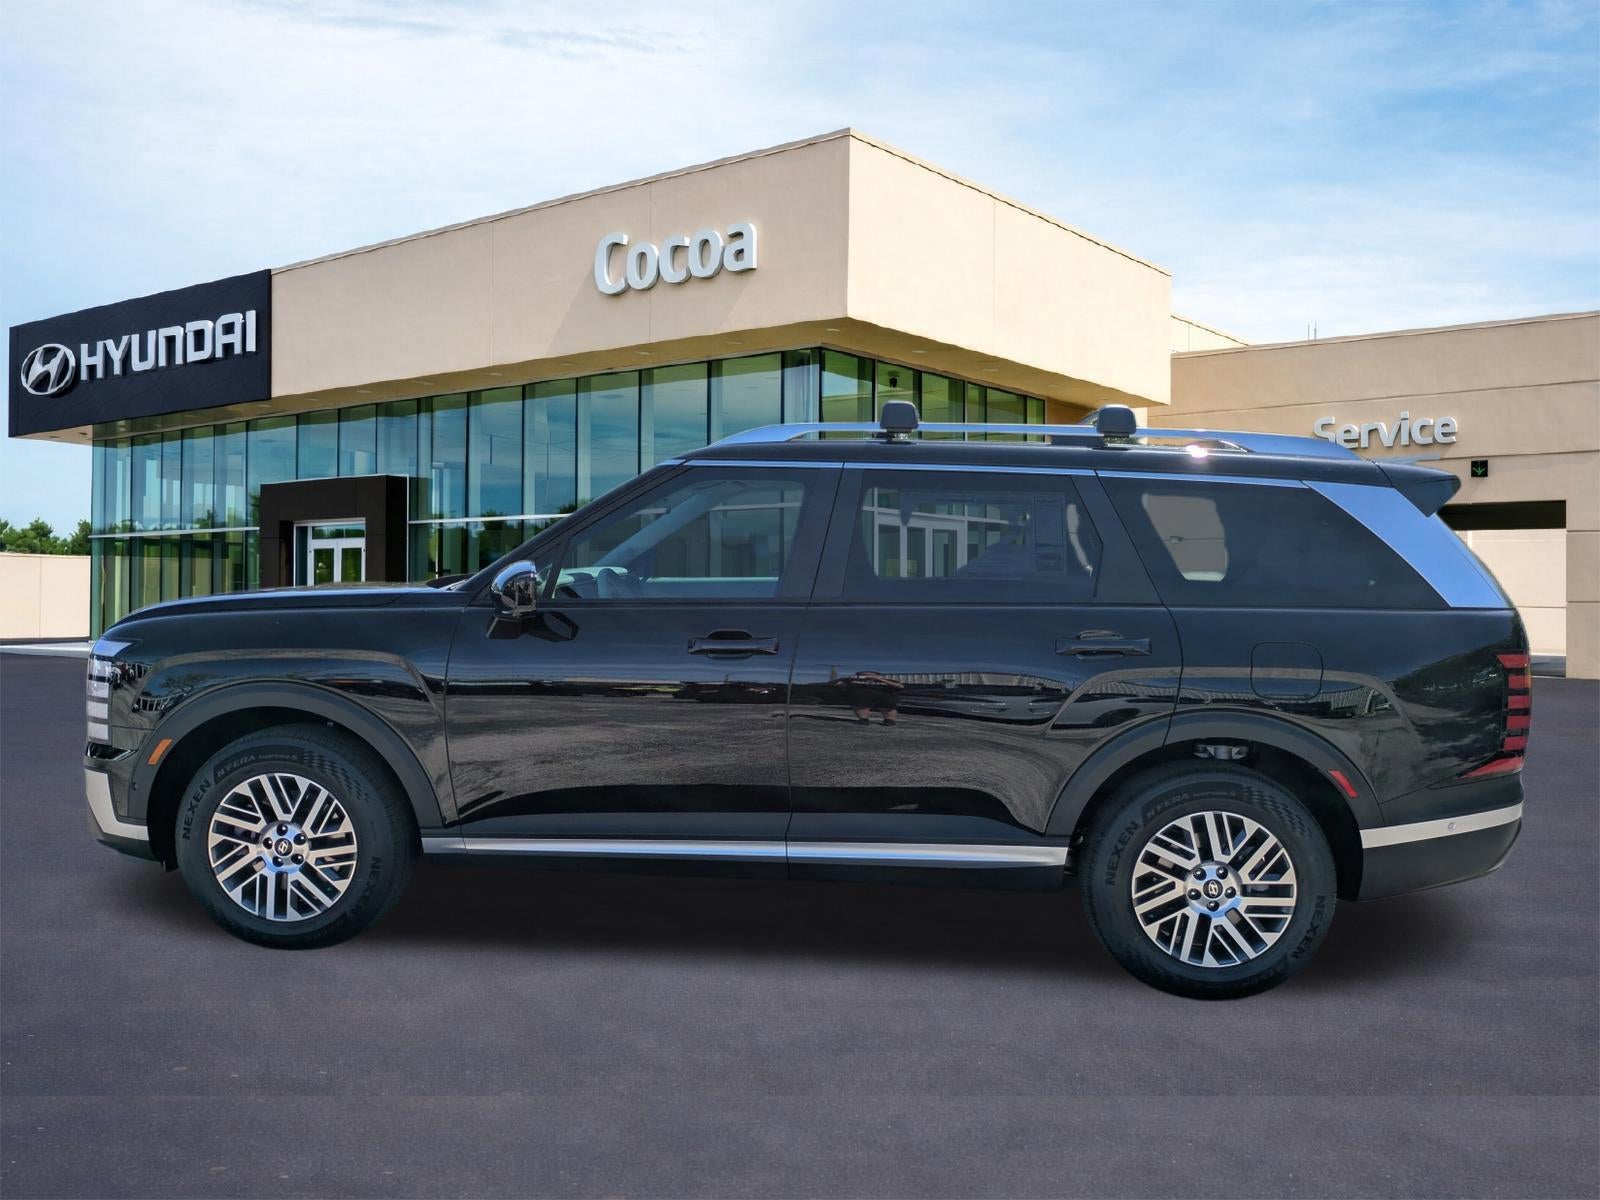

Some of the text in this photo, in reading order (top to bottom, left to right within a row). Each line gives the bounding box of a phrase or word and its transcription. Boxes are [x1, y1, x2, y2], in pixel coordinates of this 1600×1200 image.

[594, 222, 757, 295] Cocoa
[80, 309, 256, 381] HYUNDAI
[1313, 411, 1458, 449] Service
[182, 779, 212, 840] NEXEN
[1105, 820, 1140, 885] NEXEN
[1290, 895, 1326, 959] NEXEN
